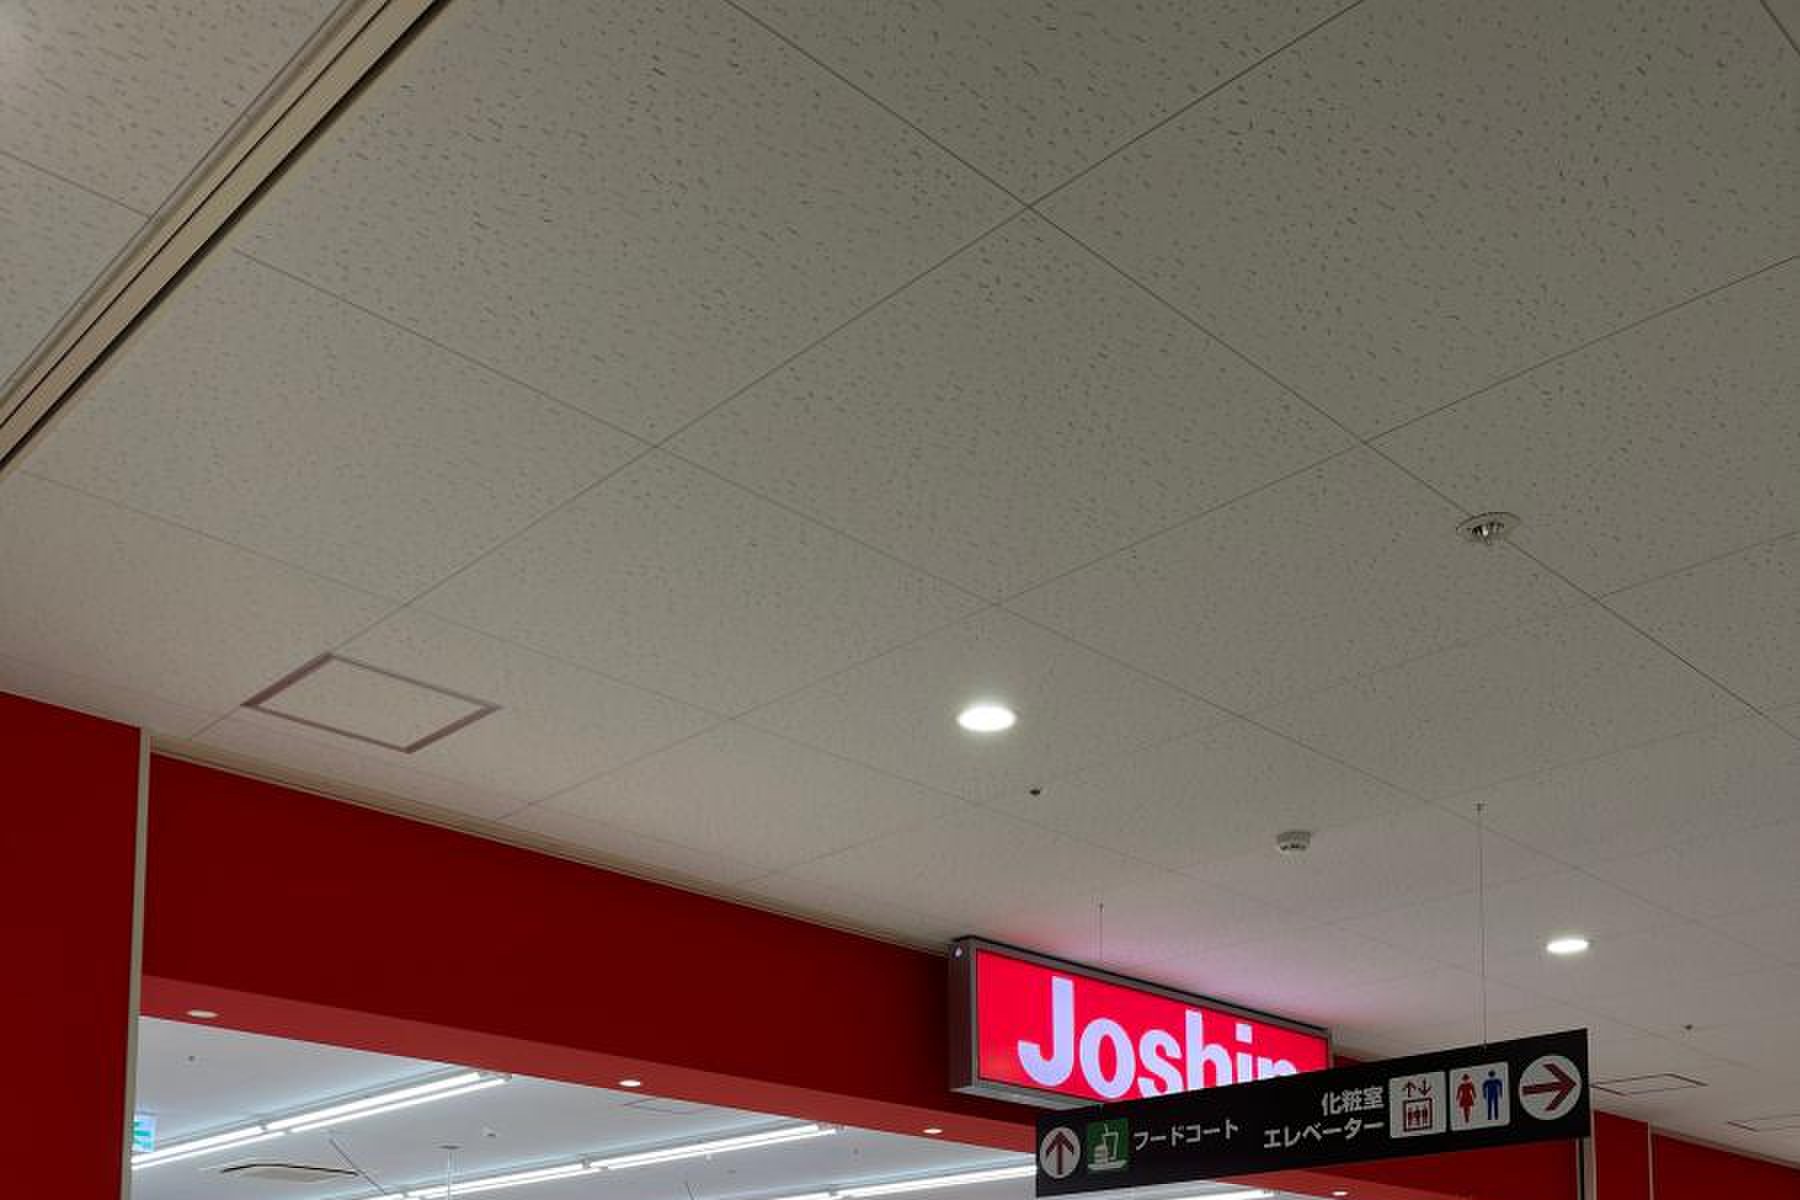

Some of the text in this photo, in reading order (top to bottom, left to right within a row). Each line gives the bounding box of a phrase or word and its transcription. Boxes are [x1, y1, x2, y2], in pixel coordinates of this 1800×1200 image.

[1321, 1086, 1385, 1117] 化粧室
[1134, 1119, 1239, 1150] フードコート
[1263, 1118, 1385, 1149] エレベーター
